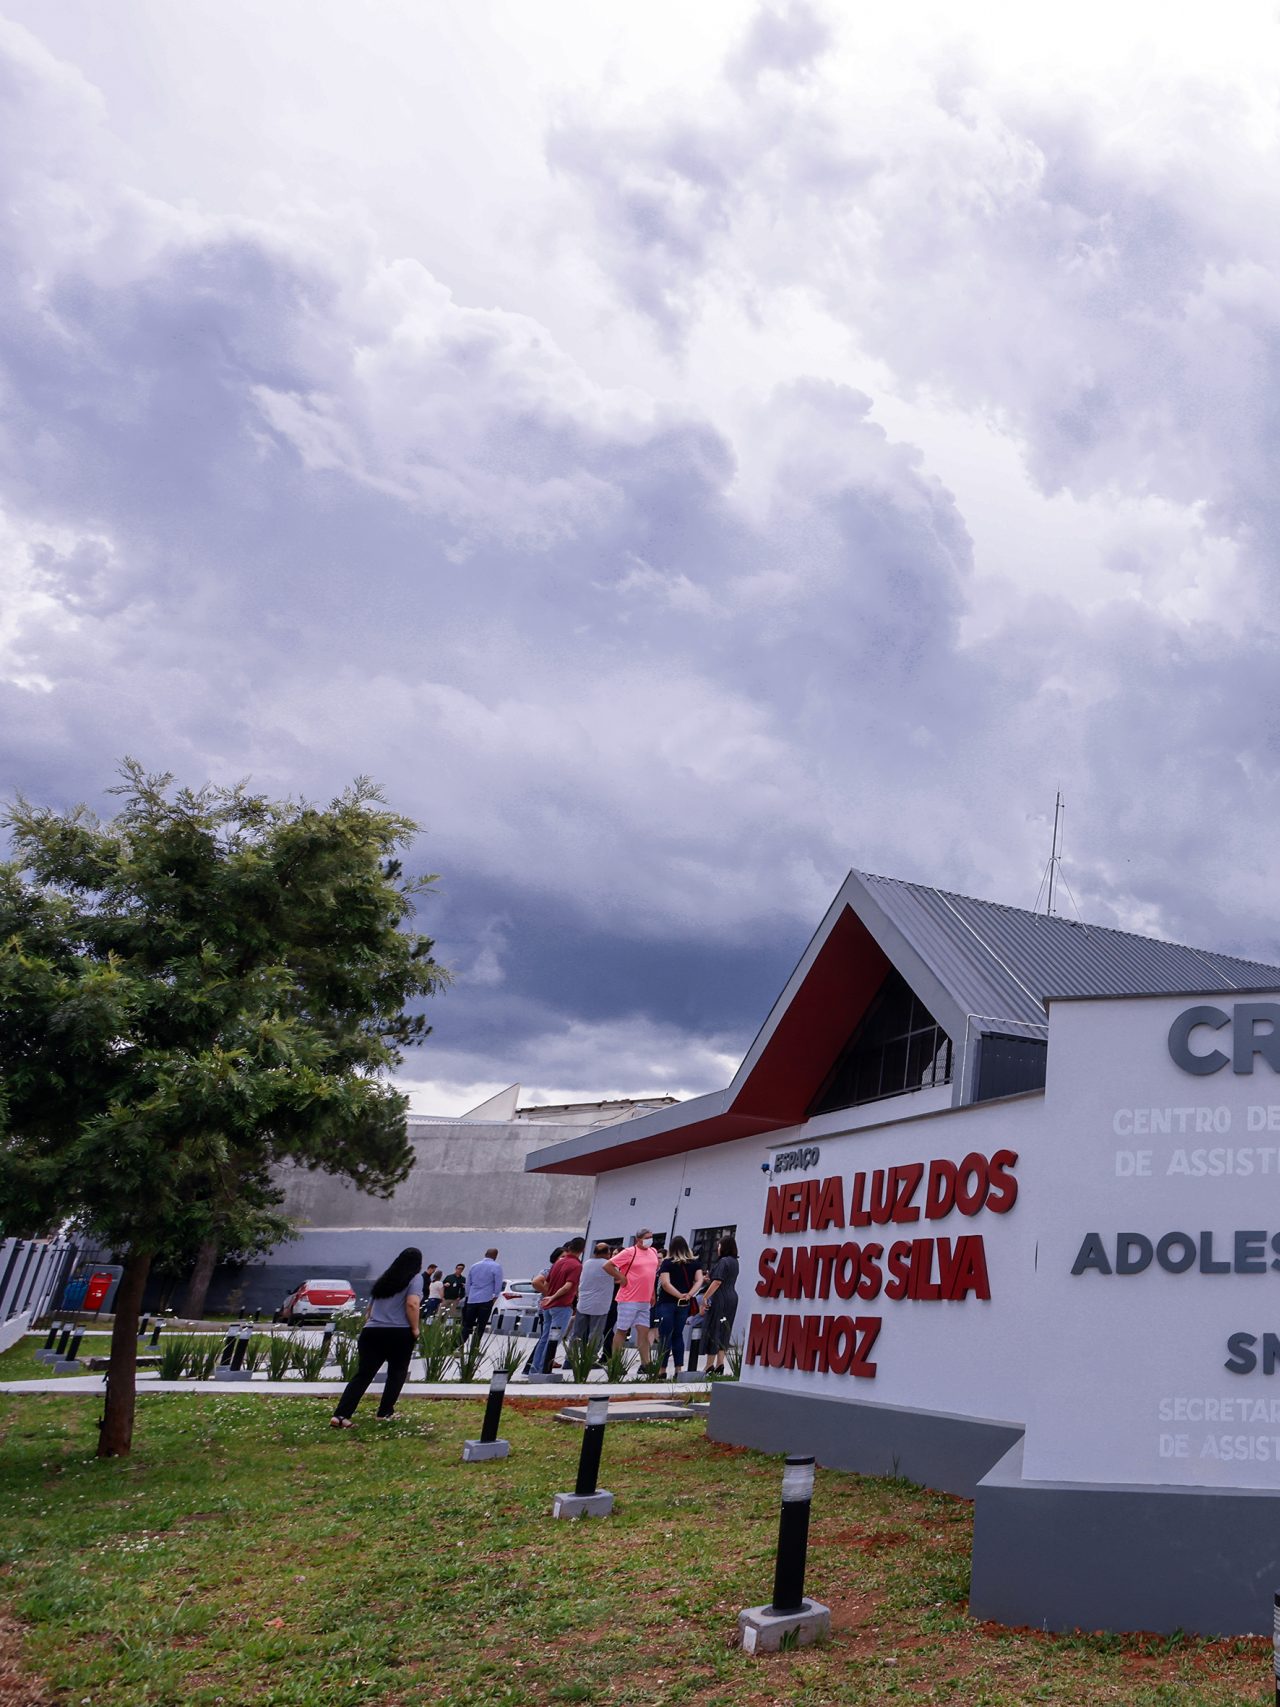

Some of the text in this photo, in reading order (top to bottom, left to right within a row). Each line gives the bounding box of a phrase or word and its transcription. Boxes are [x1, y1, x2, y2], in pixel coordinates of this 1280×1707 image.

[1112, 1105, 1232, 1136] CENTRO
[774, 1147, 820, 1173] ESPAÇO
[1115, 1150, 1153, 1177] DE
[763, 1149, 1019, 1235] NEIVA LUZ DOS
[755, 1234, 991, 1300] SANTOS SILVA
[745, 1313, 882, 1378] MUNHOZ
[1159, 1433, 1190, 1458] DE
